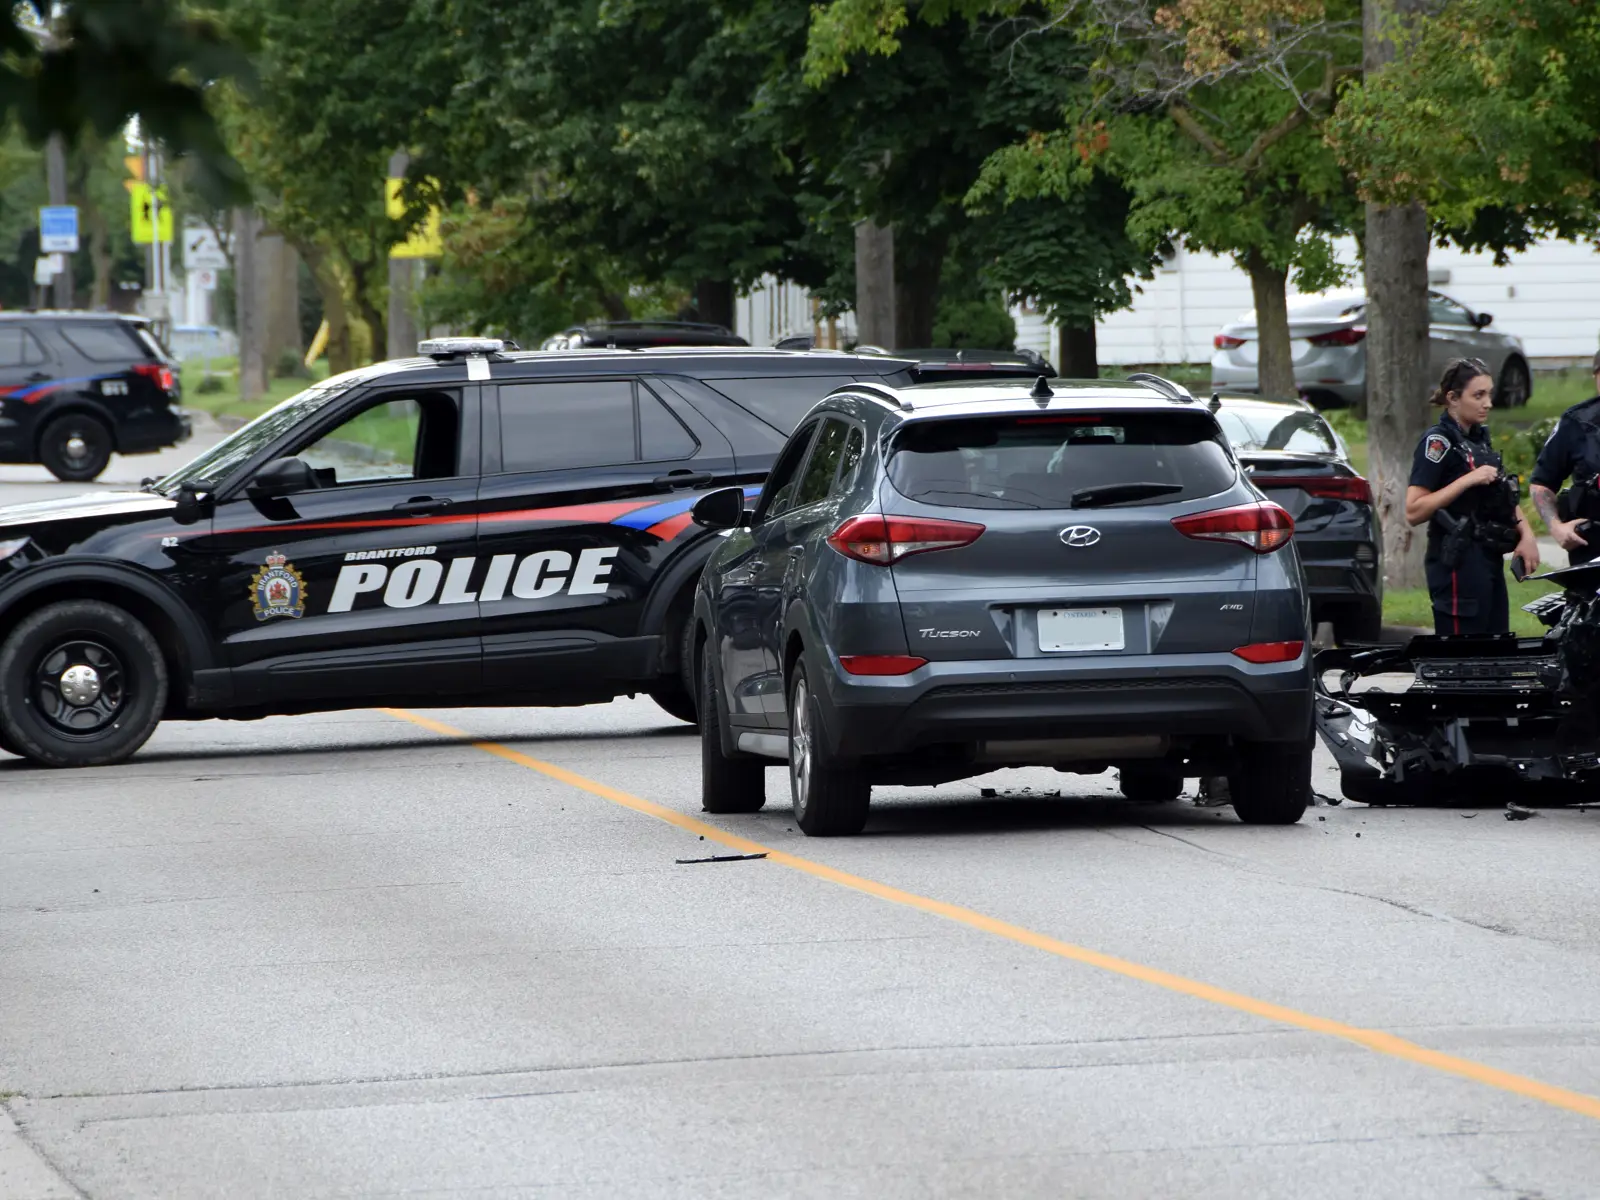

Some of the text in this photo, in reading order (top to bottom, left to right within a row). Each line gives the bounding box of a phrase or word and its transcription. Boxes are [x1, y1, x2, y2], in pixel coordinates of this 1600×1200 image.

[344, 546, 438, 561] BRANTFORD
[257, 569, 299, 591] BRANTFORD
[327, 546, 619, 613] POLICE
[264, 607, 295, 617] POLICE
[1063, 611, 1097, 619] ONTARIO
